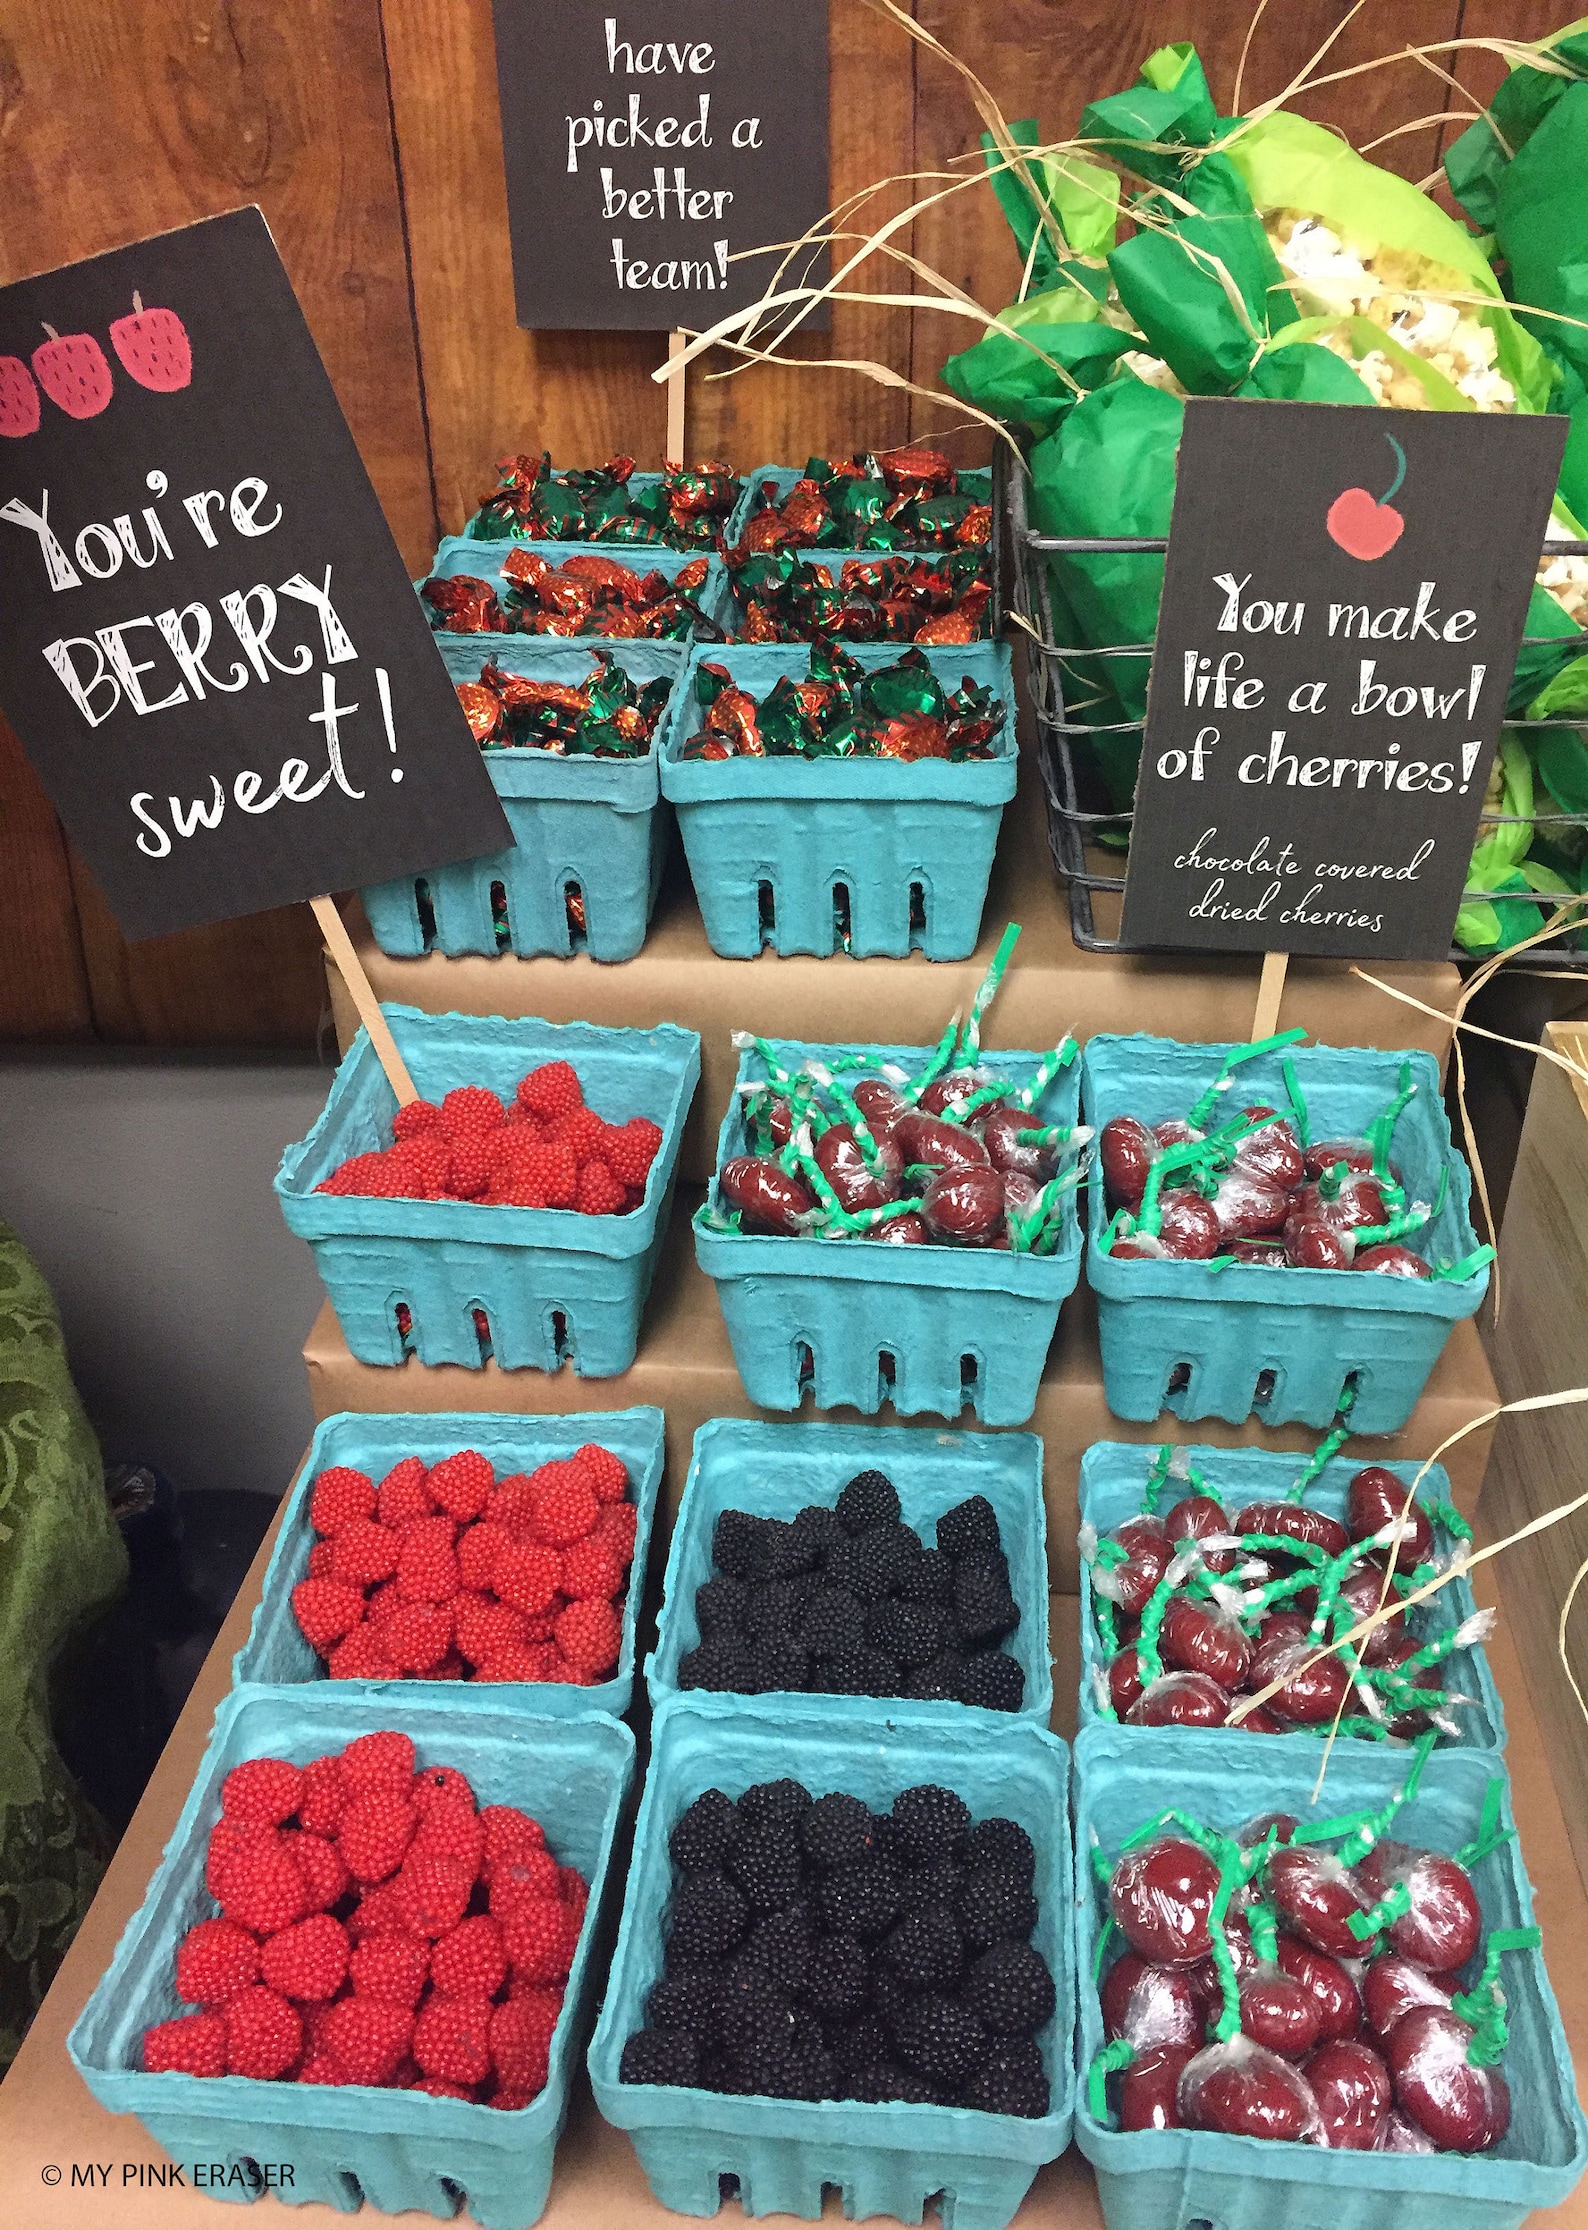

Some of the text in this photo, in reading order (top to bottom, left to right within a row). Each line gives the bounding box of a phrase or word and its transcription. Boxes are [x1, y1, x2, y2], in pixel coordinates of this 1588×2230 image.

[604, 18, 715, 74] have
[565, 93, 763, 172] picked a
[600, 167, 734, 220] better
[610, 238, 729, 290] team!
[0, 470, 282, 592] You're
[1212, 572, 1477, 643] You make
[42, 564, 358, 728] BERRY
[1184, 650, 1486, 720] life a bowl
[130, 667, 404, 858] sweet!
[1156, 726, 1482, 794] of cherries!
[1173, 827, 1435, 880] chocolate covered
[1188, 878, 1382, 932] dried cherries
